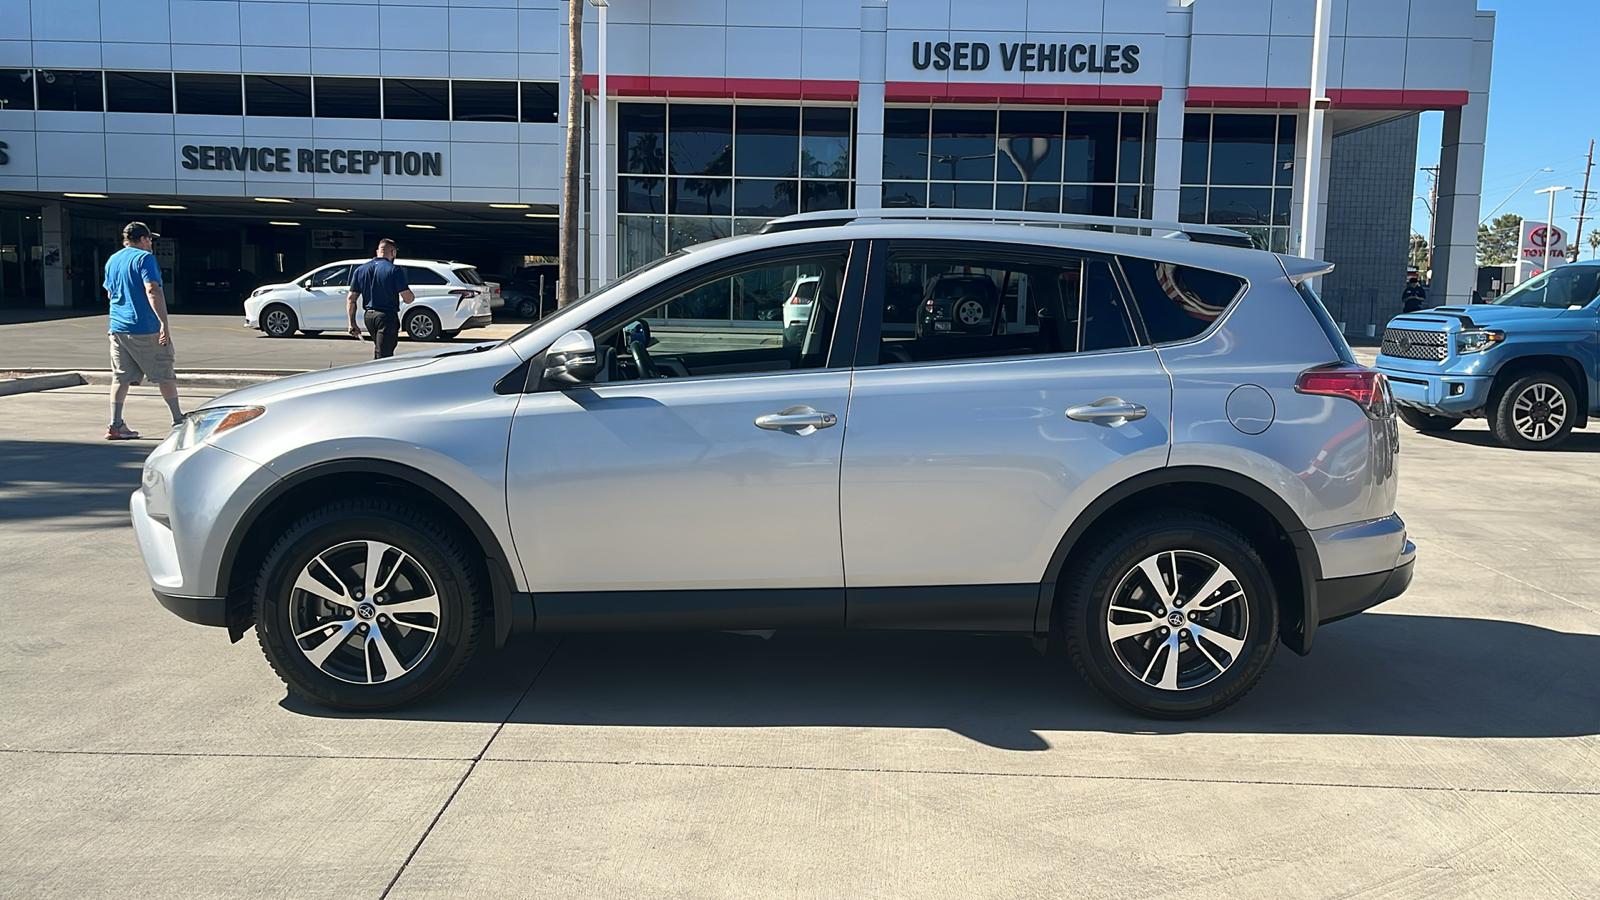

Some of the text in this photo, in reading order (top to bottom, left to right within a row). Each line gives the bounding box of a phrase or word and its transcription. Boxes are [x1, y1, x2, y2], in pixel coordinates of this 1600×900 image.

[912, 41, 1140, 73] USED VEHICLES
[181, 145, 442, 176] SERVICE RECEPTION
